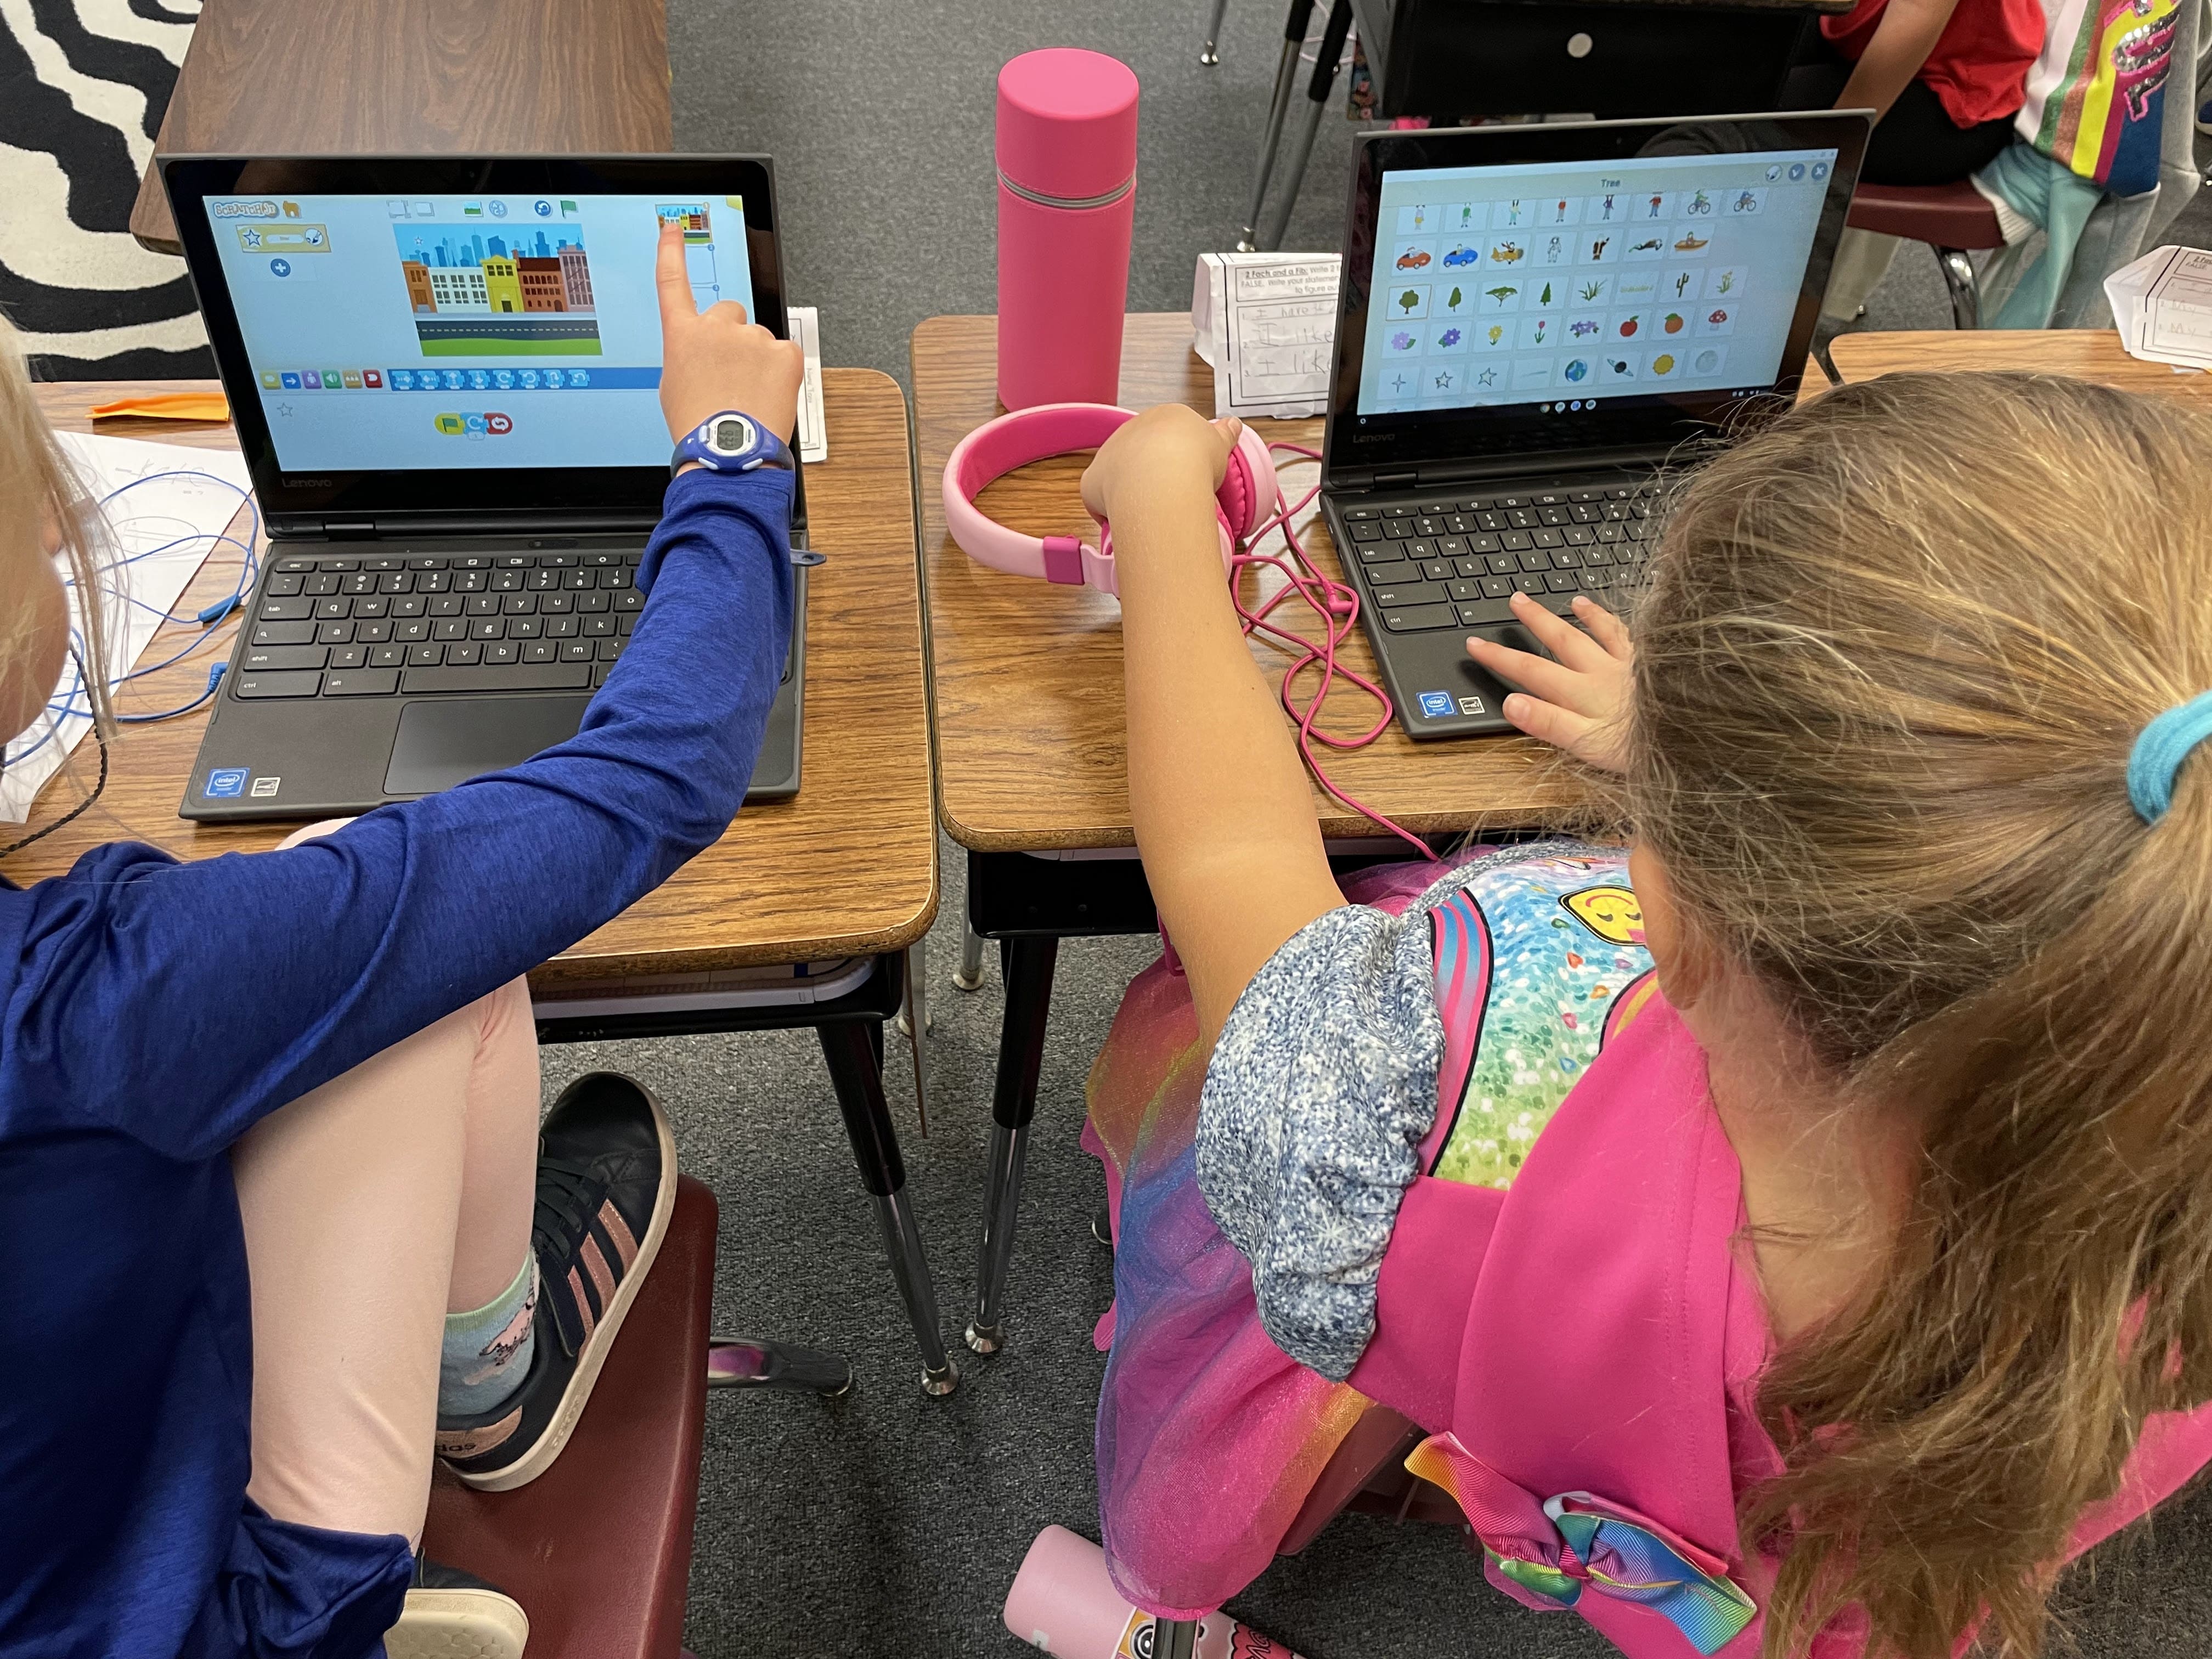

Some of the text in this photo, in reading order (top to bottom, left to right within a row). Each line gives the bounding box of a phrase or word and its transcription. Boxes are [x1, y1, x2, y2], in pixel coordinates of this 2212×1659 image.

[1601, 179, 1620, 187] Tree
[1352, 433, 1396, 444] Lenovo
[281, 478, 332, 488] Lenovo
